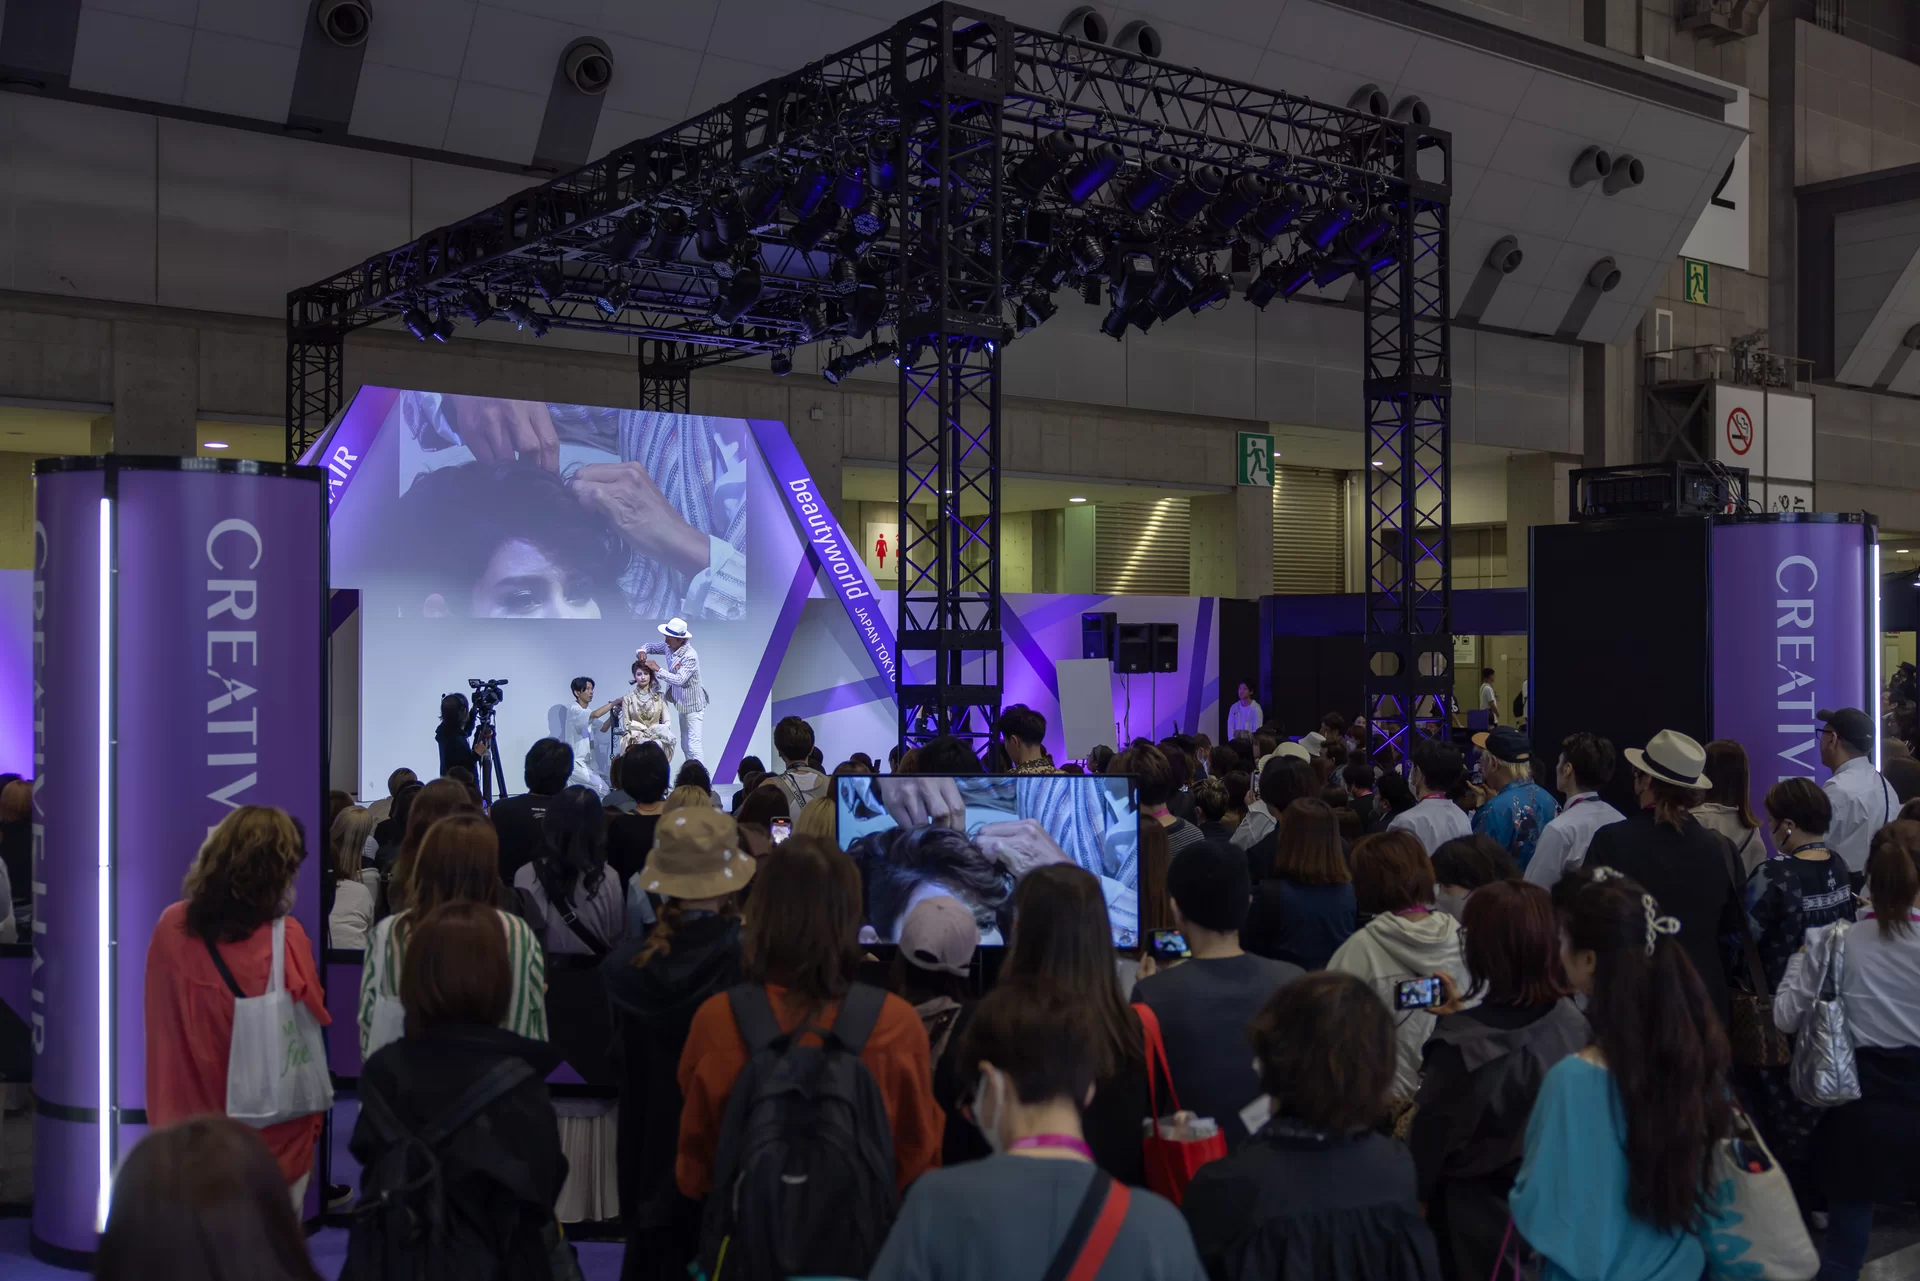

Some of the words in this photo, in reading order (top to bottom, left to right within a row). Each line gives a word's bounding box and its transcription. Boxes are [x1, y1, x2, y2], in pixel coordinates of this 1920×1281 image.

[328, 446, 358, 504] AIR
[789, 478, 869, 600] beautyworld
[855, 607, 880, 644] JAPAN
[206, 518, 262, 838] CREATIV
[1776, 555, 1818, 786] CREATIV
